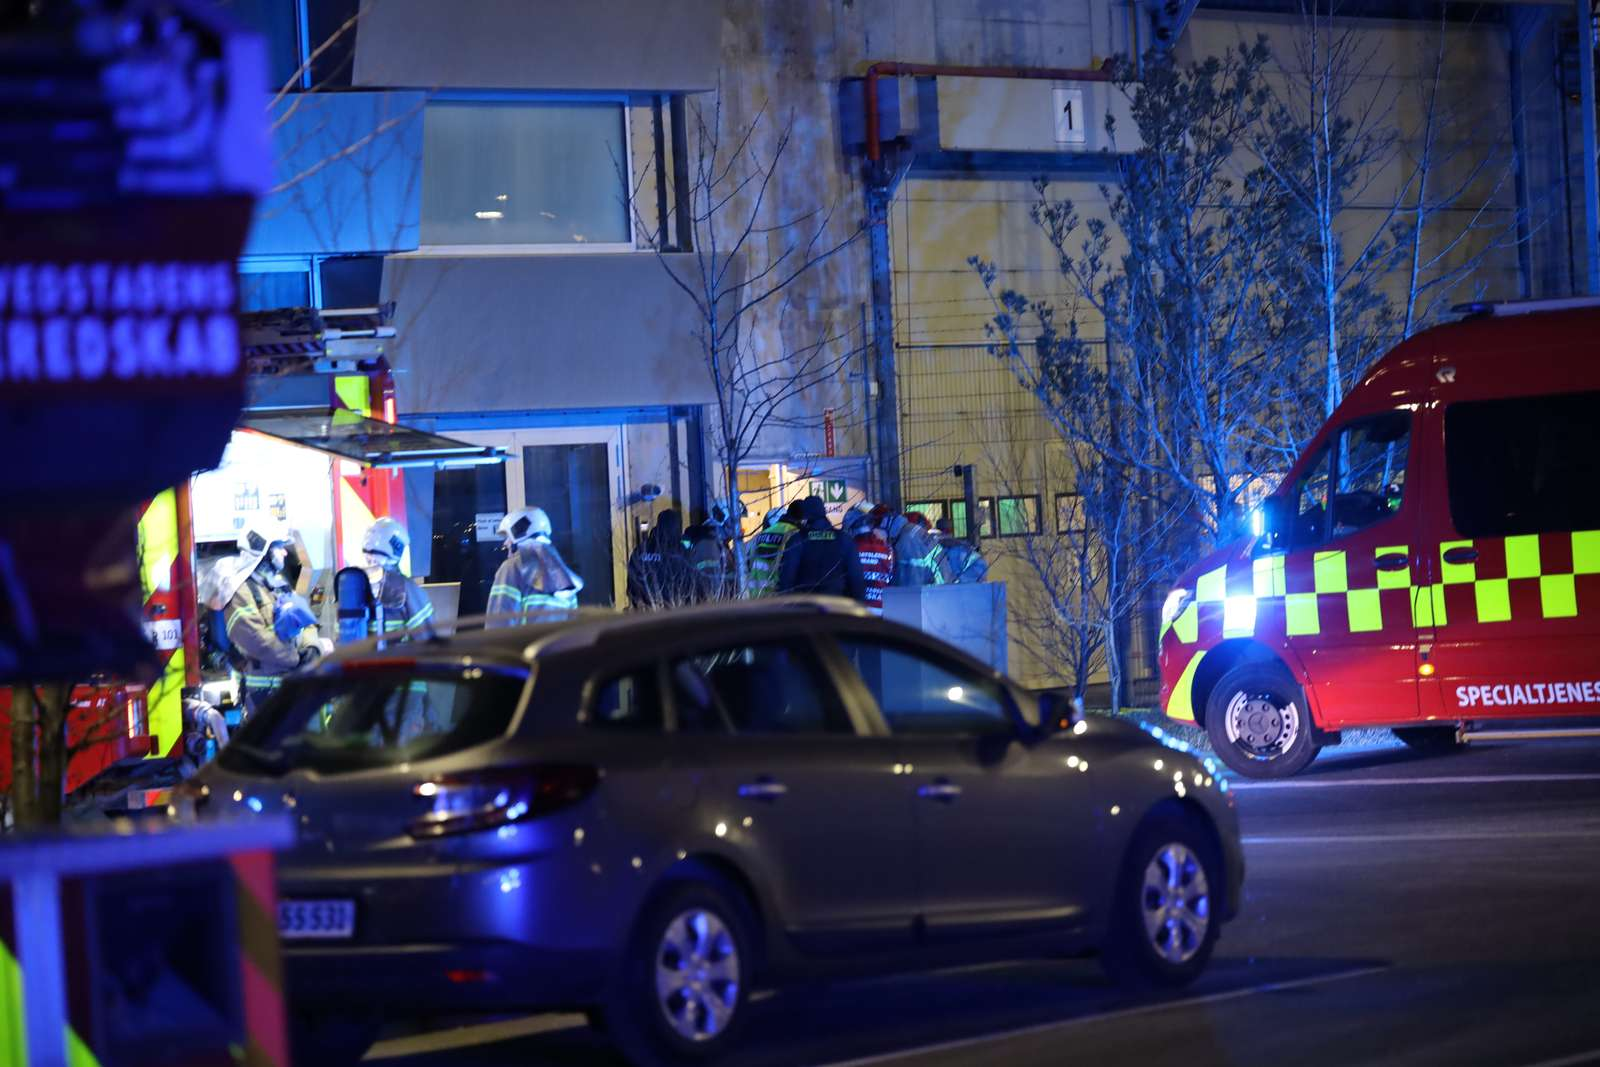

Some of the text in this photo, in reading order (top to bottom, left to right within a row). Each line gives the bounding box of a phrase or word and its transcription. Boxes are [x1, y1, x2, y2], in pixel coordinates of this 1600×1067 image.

[1064, 100, 1073, 130] 1
[0, 314, 240, 382] REDSKAB
[1456, 682, 1600, 707] SPECIALTJENES
